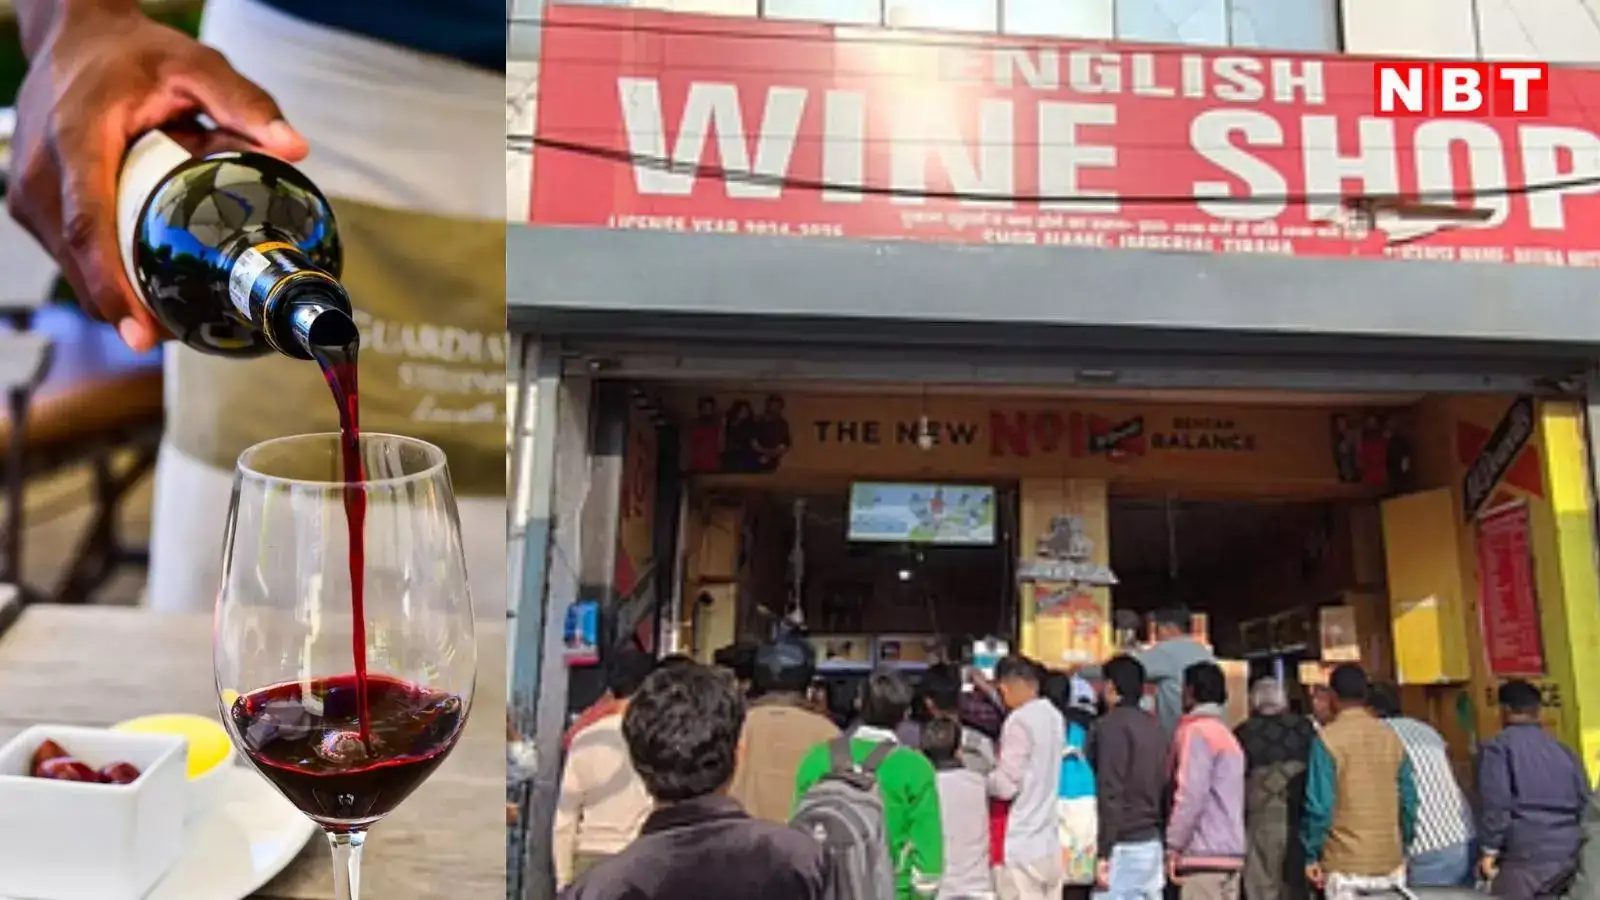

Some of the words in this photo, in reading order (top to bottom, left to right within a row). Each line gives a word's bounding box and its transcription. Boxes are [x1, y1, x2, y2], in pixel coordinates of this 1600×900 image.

[938, 47, 1326, 105] ENGLISH
[617, 76, 1120, 214] WINE
[1189, 108, 1600, 230] SHOP
[814, 420, 881, 445] THE
[896, 421, 979, 446] NEW
[1151, 431, 1258, 451] BALANCE
